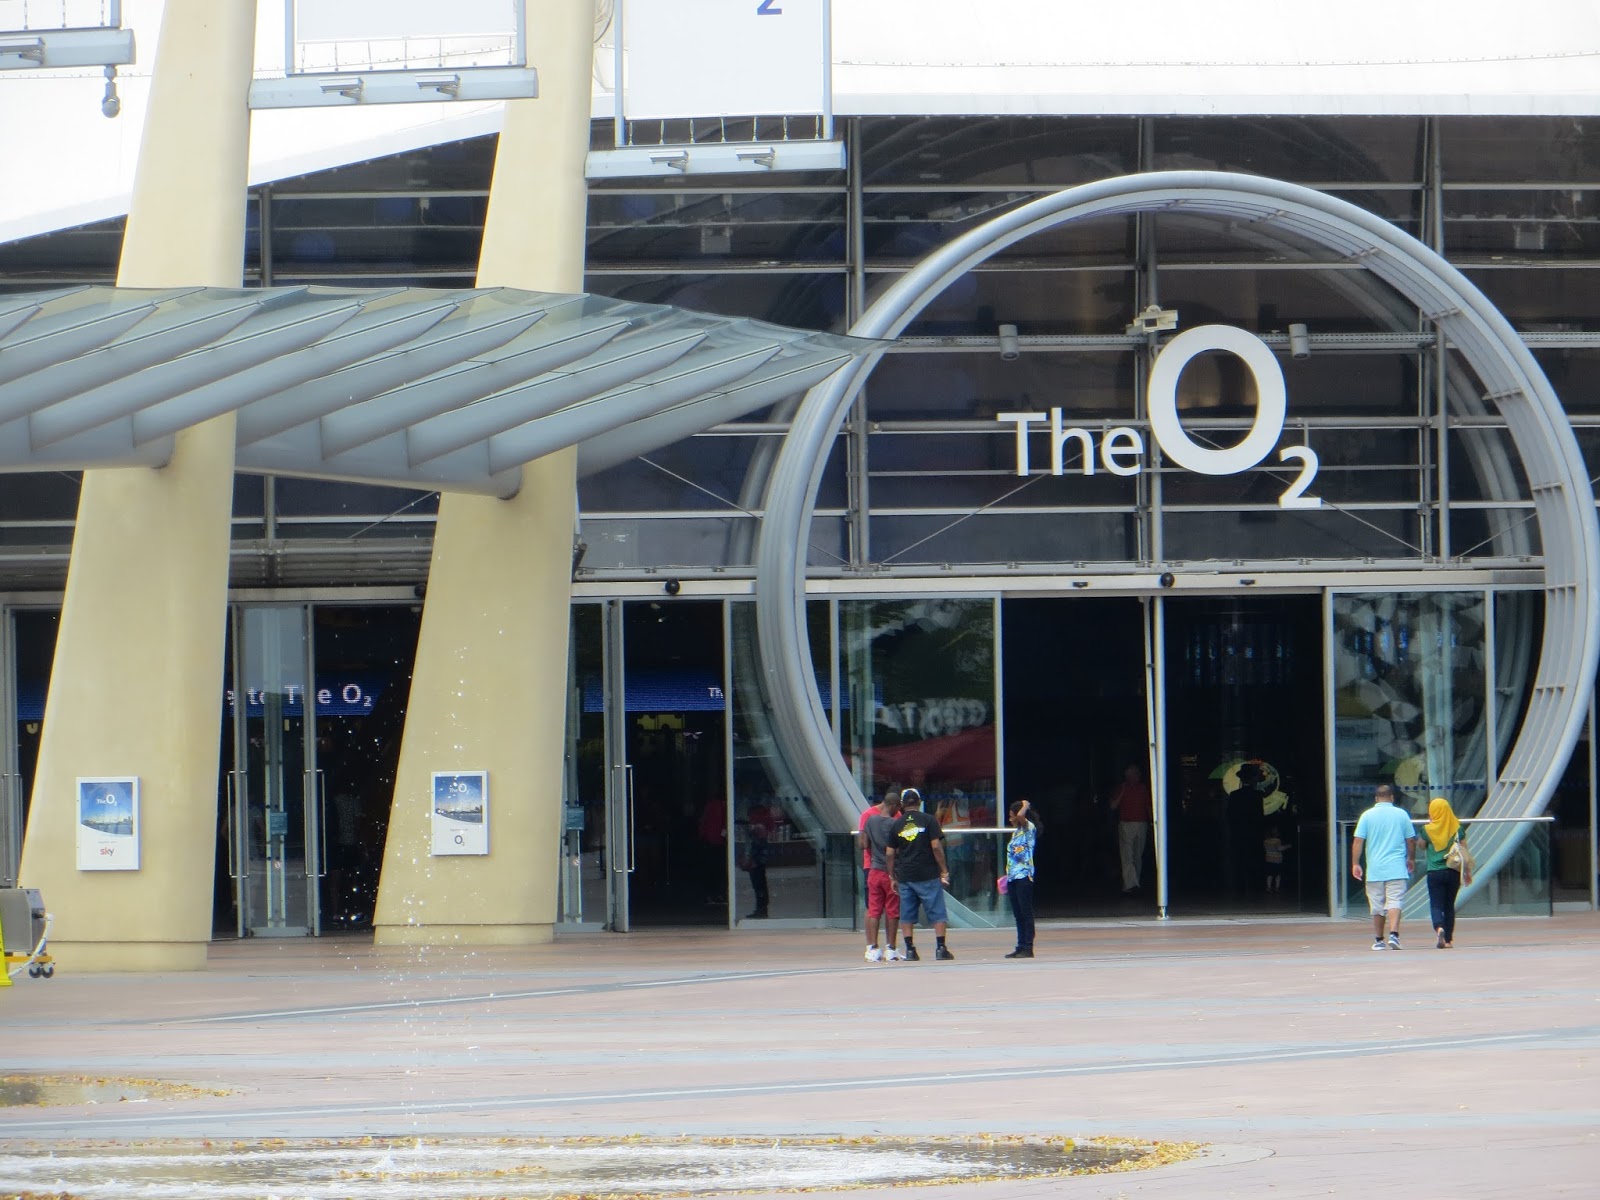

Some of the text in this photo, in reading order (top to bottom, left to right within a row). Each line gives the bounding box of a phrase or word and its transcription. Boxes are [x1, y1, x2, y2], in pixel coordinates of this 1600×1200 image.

[996, 324, 1322, 509] The O2
[99, 846, 115, 857] sky
